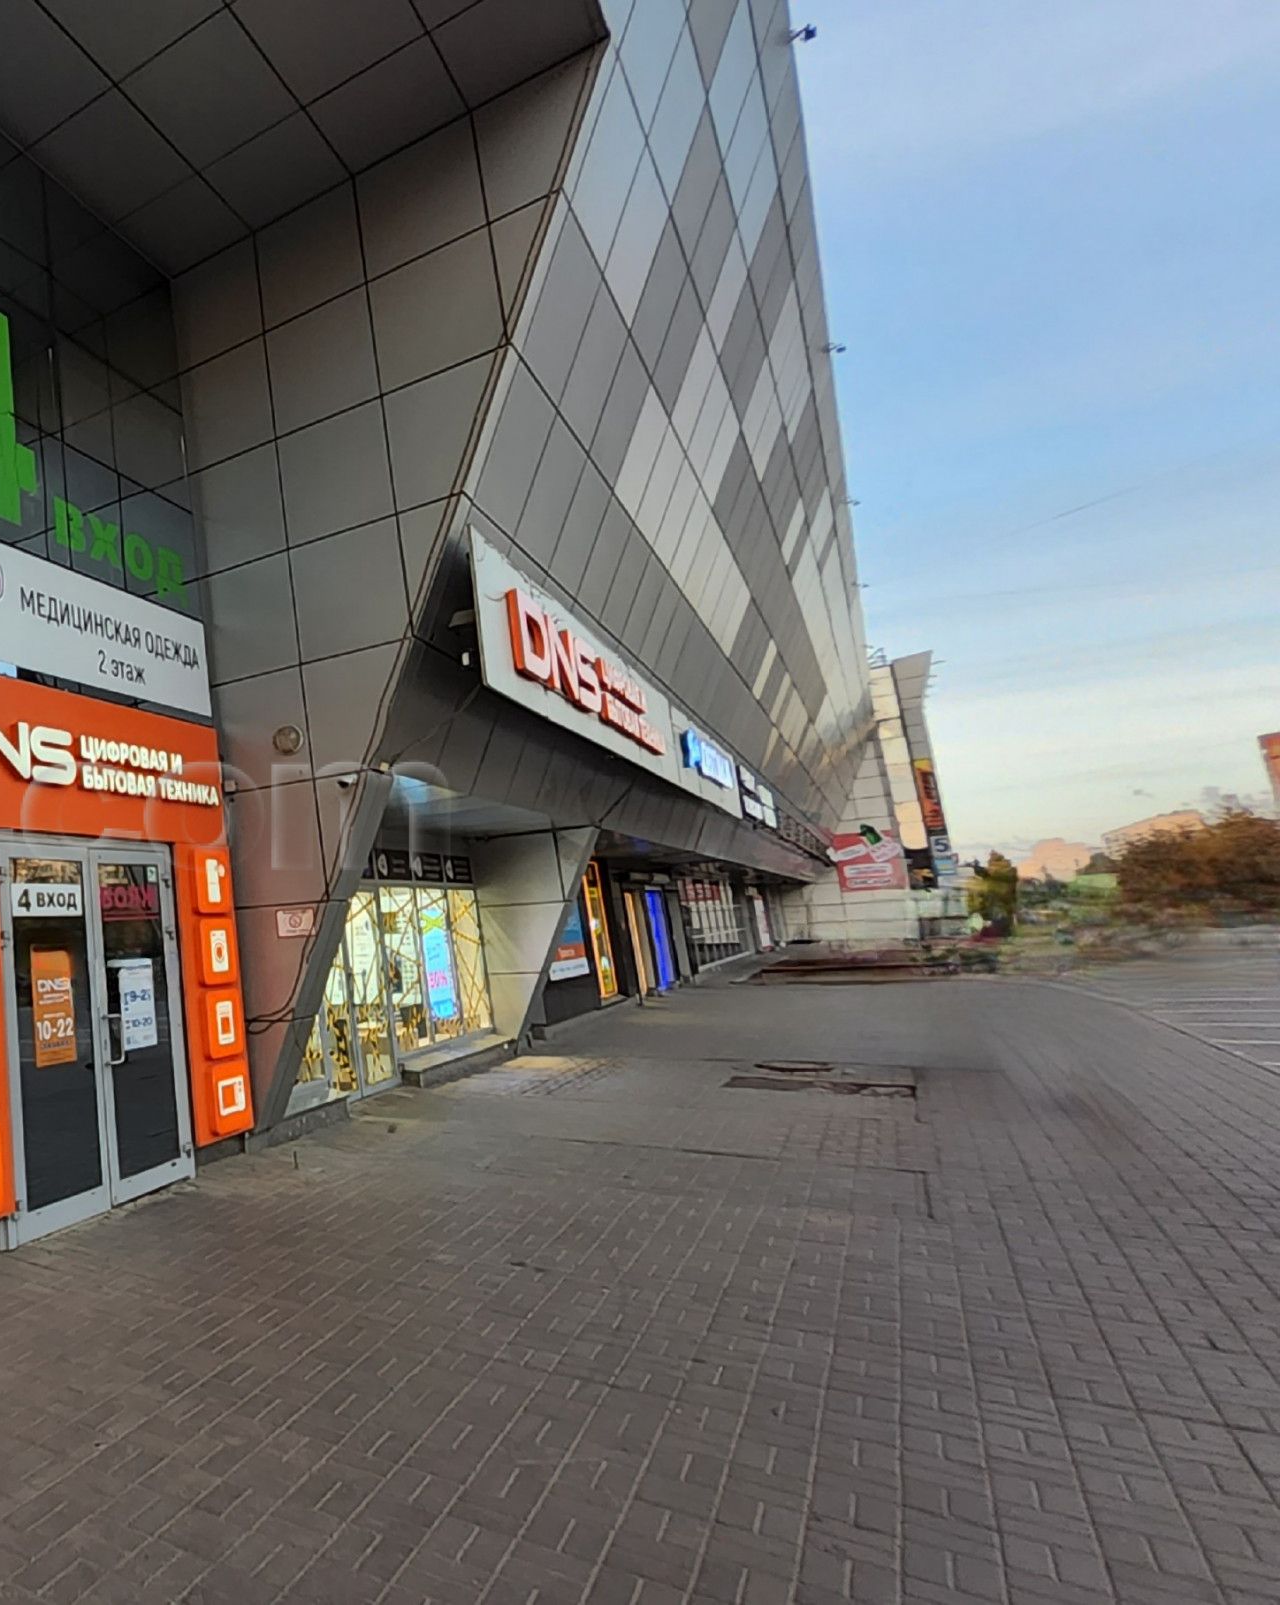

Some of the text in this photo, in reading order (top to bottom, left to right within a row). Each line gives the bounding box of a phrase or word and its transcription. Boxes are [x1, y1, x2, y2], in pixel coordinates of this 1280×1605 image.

[20, 586, 200, 670] МЕДИЦИНСКАЯ ОДЕЖДА
[97, 649, 146, 685] 2 этаж
[506, 587, 605, 714] DNS
[80, 734, 184, 776] ЦИФРОВАЯ И
[83, 765, 220, 807] БЫТОВАЯ ТЕХНИКА
[17, 888, 31, 912] 4
[36, 892, 78, 911] ВХОД
[36, 1017, 75, 1041] 10-22
